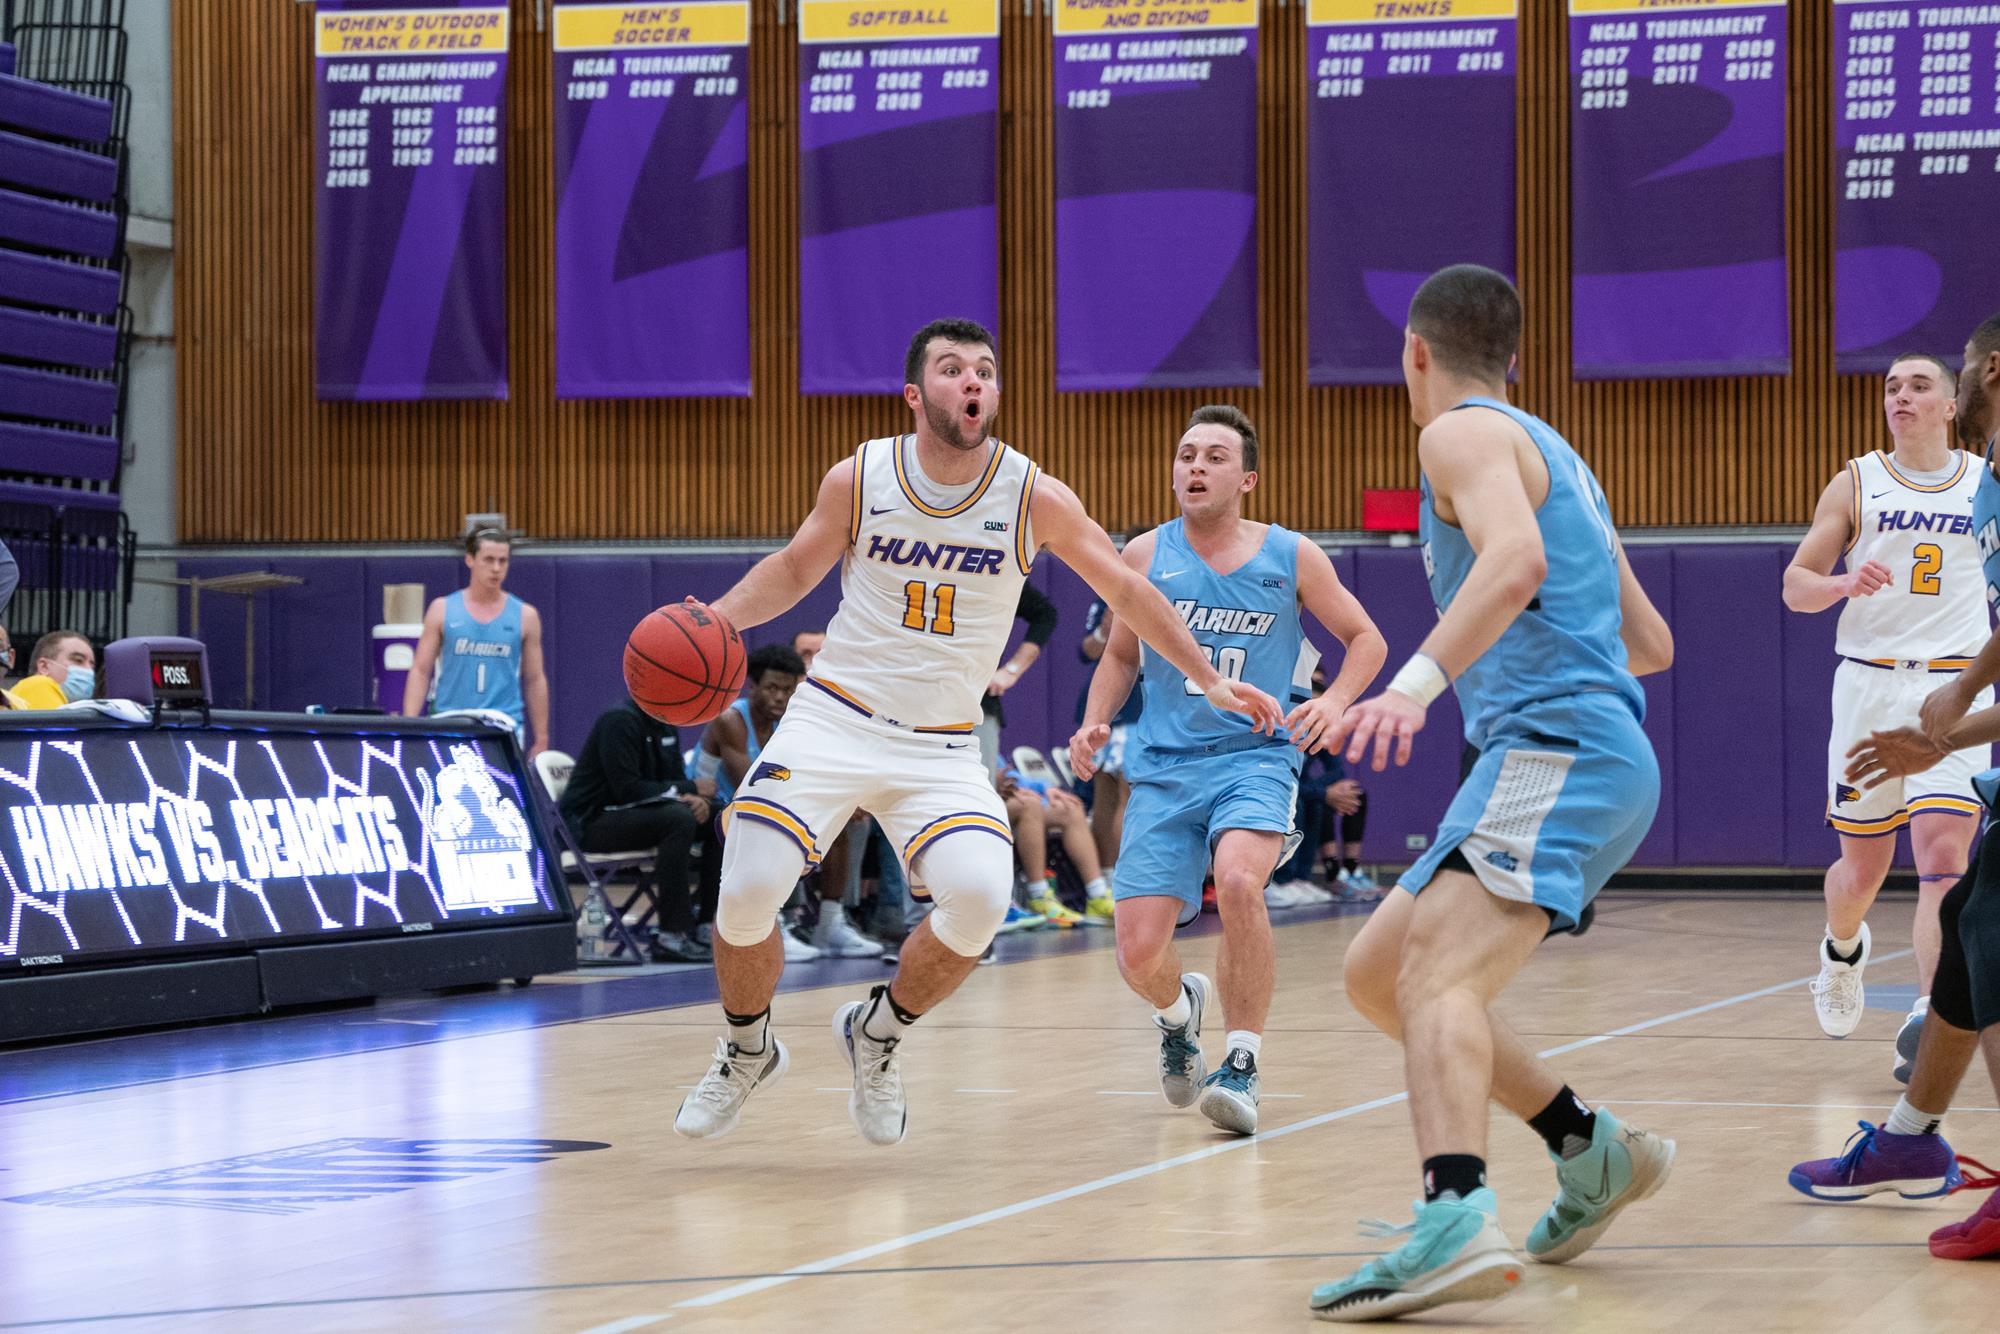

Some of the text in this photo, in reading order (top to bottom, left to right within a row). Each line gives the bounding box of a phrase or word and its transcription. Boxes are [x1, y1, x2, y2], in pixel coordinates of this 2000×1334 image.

[622, 9, 682, 24] MEN'S
[848, 10, 949, 27] SOFTBALL
[1146, 10, 1210, 25] DIVING
[1375, 2, 1450, 17] TENNIS
[1850, 10, 1909, 30] NECVA
[324, 14, 499, 32] WOMEN'S OUTDOOR
[1590, 16, 1766, 41] NCAA TOURNAMENT
[342, 34, 482, 50] TRACK & FIELD
[613, 28, 691, 44] SOCCER
[1327, 28, 1498, 51] NCAA TOURNAMENT
[818, 47, 980, 68] NCAA TOURNAMENT
[1065, 37, 1247, 61] NCAA CHAMPIONSHIP
[1581, 47, 1629, 66] 2007
[327, 61, 497, 82] NCAA CHAMPIONSHIP
[573, 55, 731, 76] NCAA TOURNAMENT
[1101, 62, 1211, 83] APPEARANCE
[1318, 52, 1503, 76] 2010 2011 2015
[1581, 61, 1773, 88] 2010 2011 2012
[1846, 53, 1971, 76] 2001 2002
[360, 85, 463, 103] APPEARANCE
[1846, 75, 1971, 98] 2004 2005
[1581, 89, 1628, 109] 2013
[1846, 100, 1896, 119] 2007
[1855, 133, 1905, 153] NCAA
[1846, 158, 1894, 177] 2012
[984, 521, 1008, 531] CUNY
[867, 535, 1005, 575] HUNTER
[1910, 542, 1943, 596] 2
[901, 580, 956, 637] 11
[1174, 599, 1278, 637] BARUCH
[163, 665, 190, 684] POSS.
[476, 662, 487, 693] 1
[1184, 644, 1247, 696] 0
[10, 803, 168, 892] HAWKS
[158, 799, 238, 884] VS.
[229, 795, 408, 879] BEARCATS
[20, 954, 64, 966] DAKTRONICS
